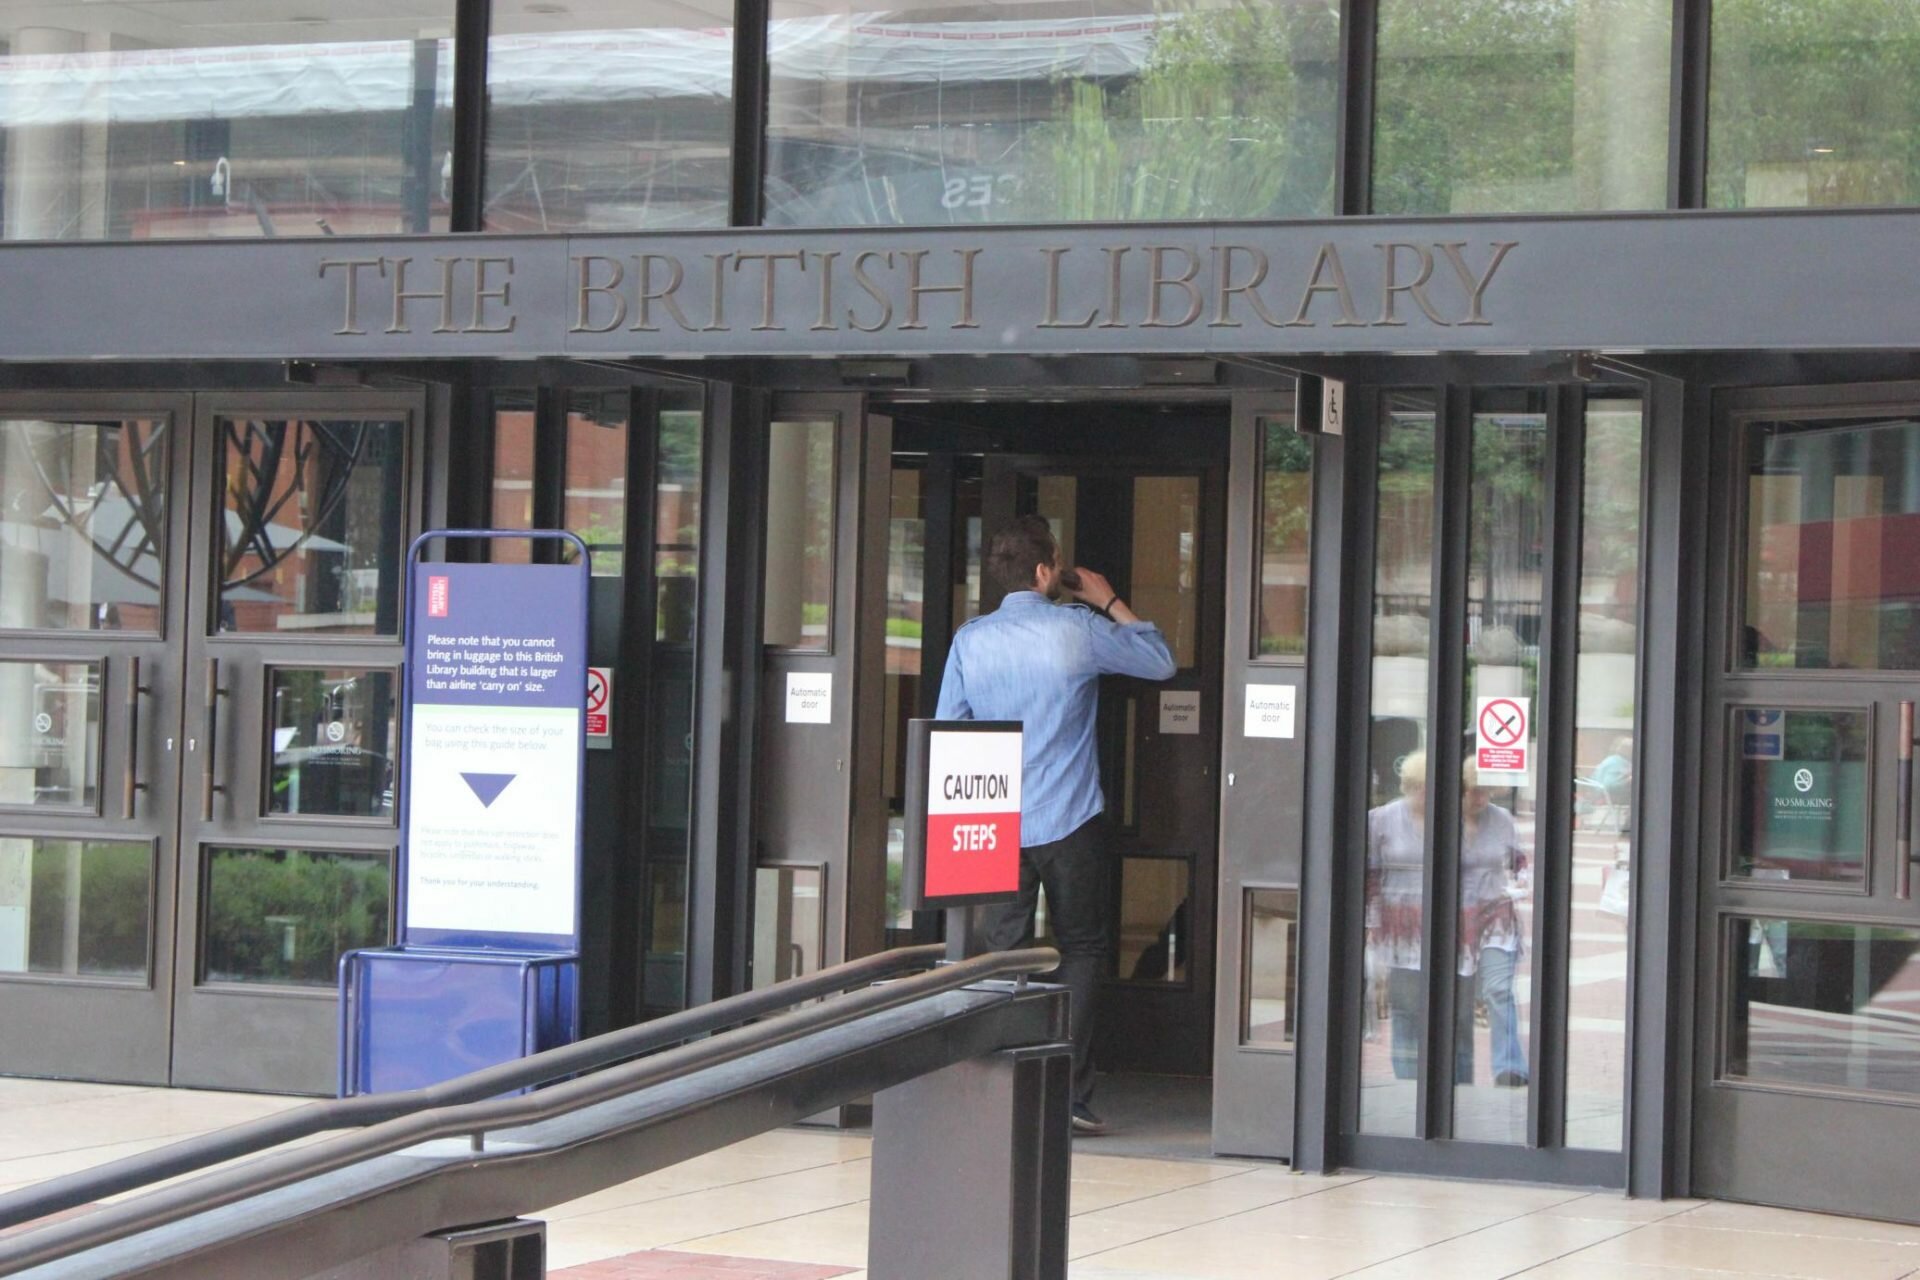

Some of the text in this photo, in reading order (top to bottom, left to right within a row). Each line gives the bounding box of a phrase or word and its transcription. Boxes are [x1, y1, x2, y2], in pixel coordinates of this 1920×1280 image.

[318, 240, 1520, 336] THE BRITISH LIBRARY
[427, 634, 556, 649] Please note that you cannot
[426, 649, 564, 663] bring in luggage to this British
[426, 664, 557, 680] Library building that is larger
[426, 679, 447, 690] than
[449, 679, 477, 691] airline
[524, 682, 545, 692] size.
[790, 687, 827, 697] Automatic
[801, 699, 819, 709] door
[1163, 703, 1197, 712] Automatic
[1249, 700, 1290, 711] Automatic
[1172, 713, 1189, 722] door
[1261, 712, 1281, 723] door
[425, 722, 442, 733] You
[445, 725, 461, 734] can
[463, 724, 489, 735] check
[492, 724, 509, 735] the
[943, 774, 1009, 801] CAUTION
[1774, 797, 1833, 808] NO SMOKING
[952, 823, 997, 852] STEPS
[420, 876, 441, 886] Thank
